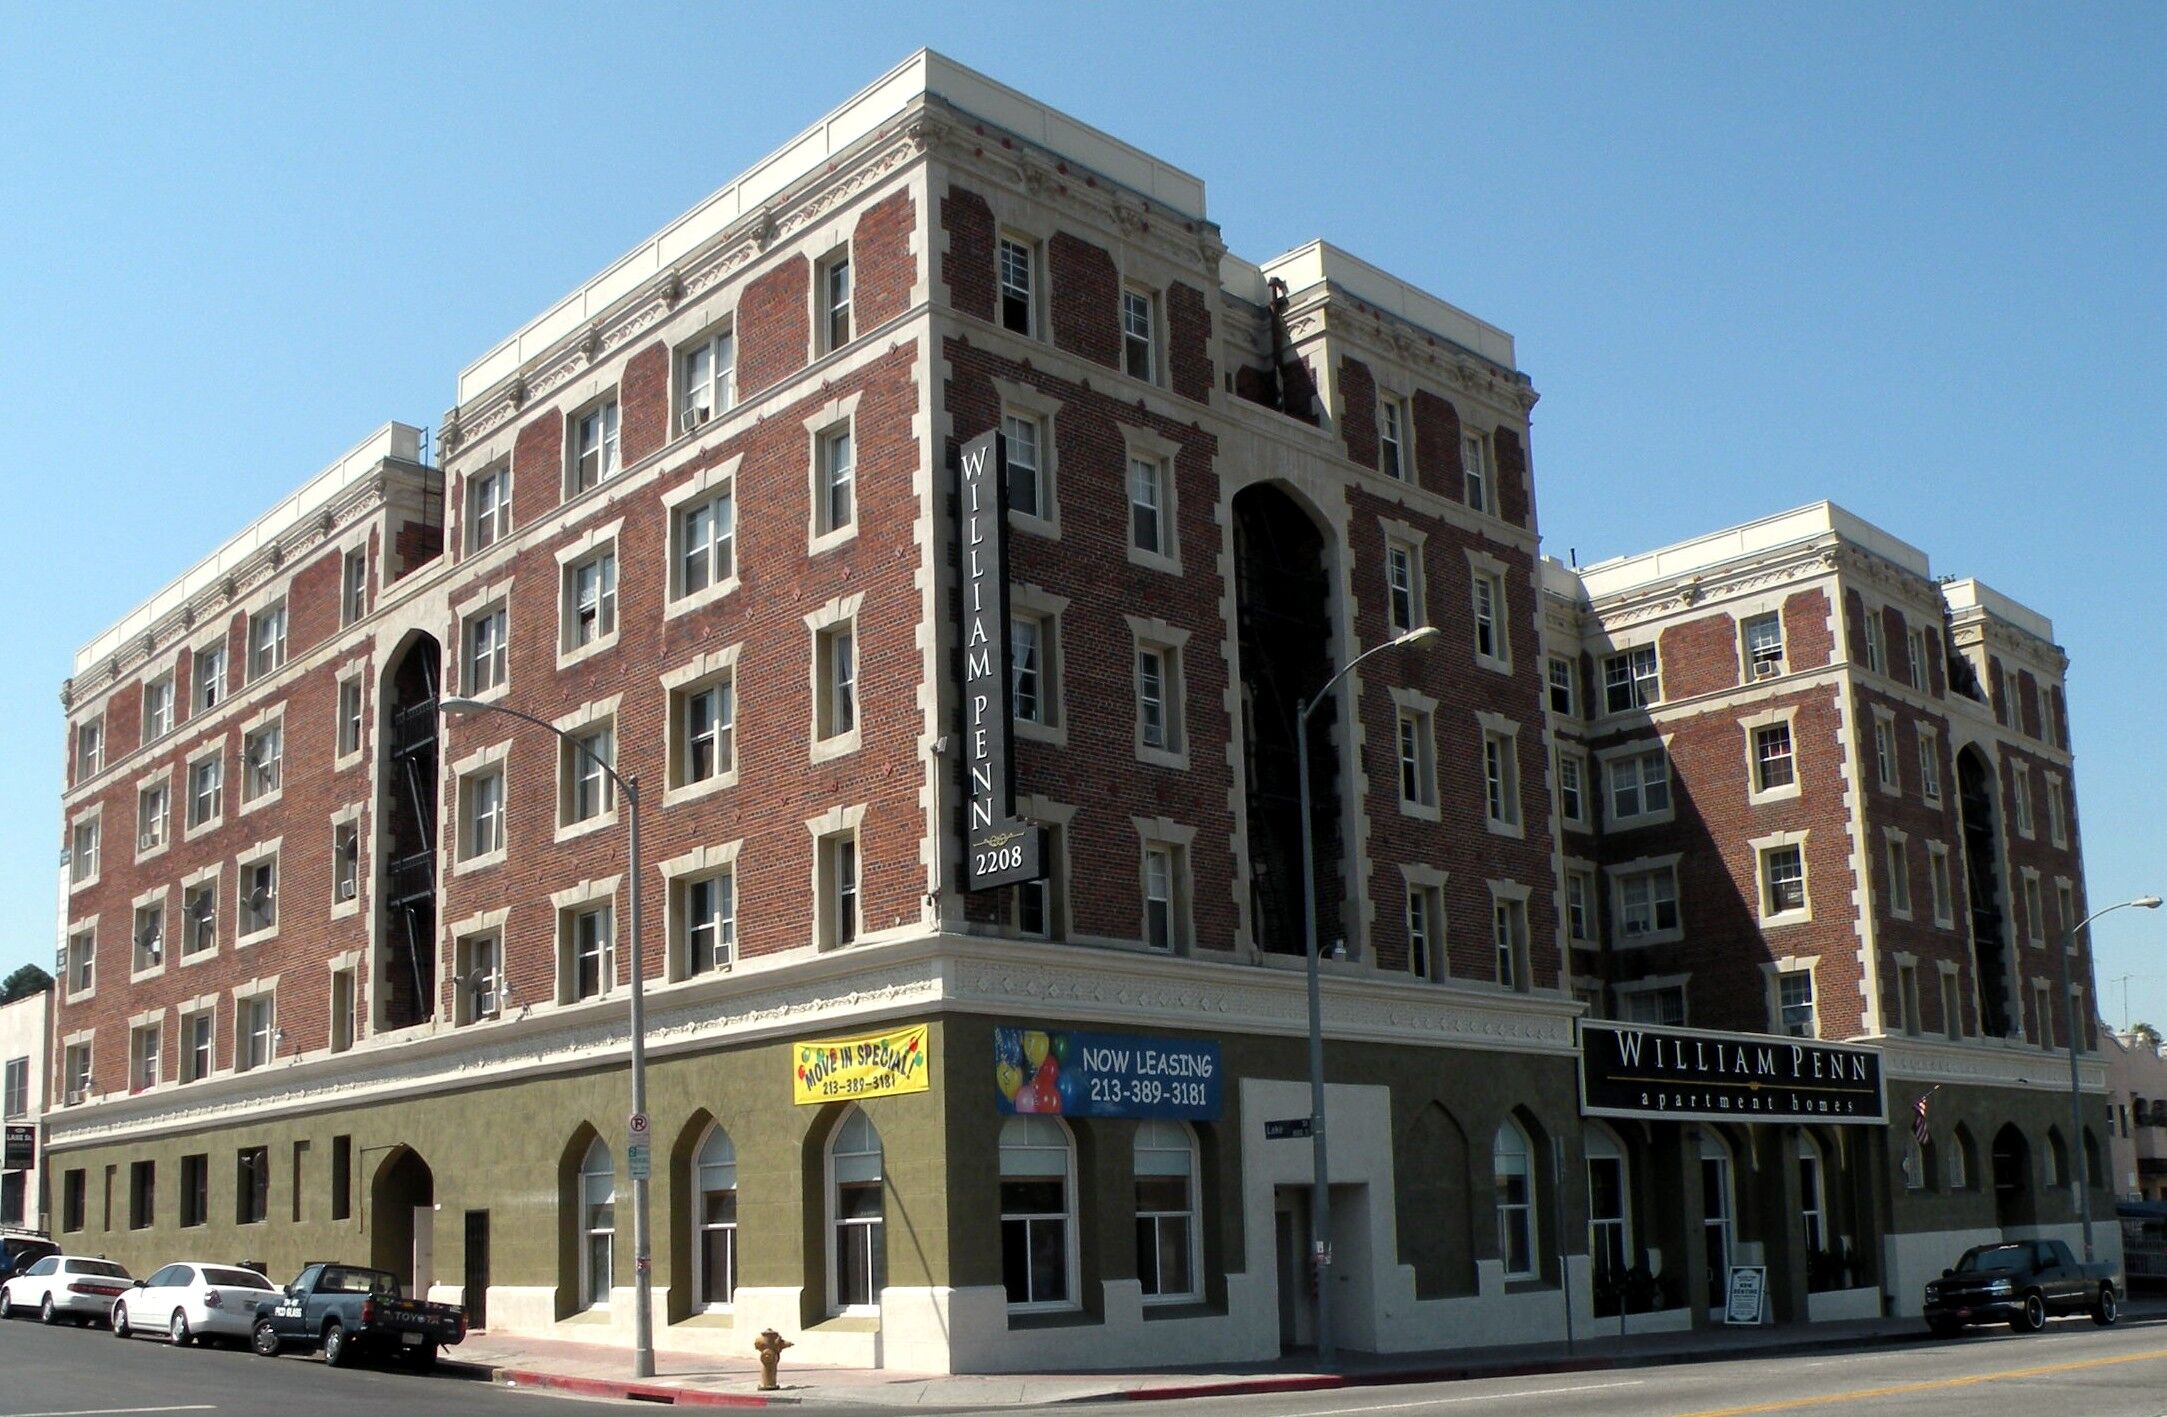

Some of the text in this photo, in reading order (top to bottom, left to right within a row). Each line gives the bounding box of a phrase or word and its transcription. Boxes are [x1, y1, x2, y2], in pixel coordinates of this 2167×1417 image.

[961, 446, 993, 831] WILLIAM PENN
[975, 845, 1023, 876] 2208
[804, 1044, 916, 1091] MOVE IN SPECIAL!
[1083, 1047, 1213, 1078] NOW LEASING
[1614, 1030, 1867, 1081] WILLIAM PENN
[823, 1074, 896, 1096] 213-389-3181
[1090, 1078, 1207, 1106] 213-389-3181
[1641, 1091, 1854, 1113] apartment homes
